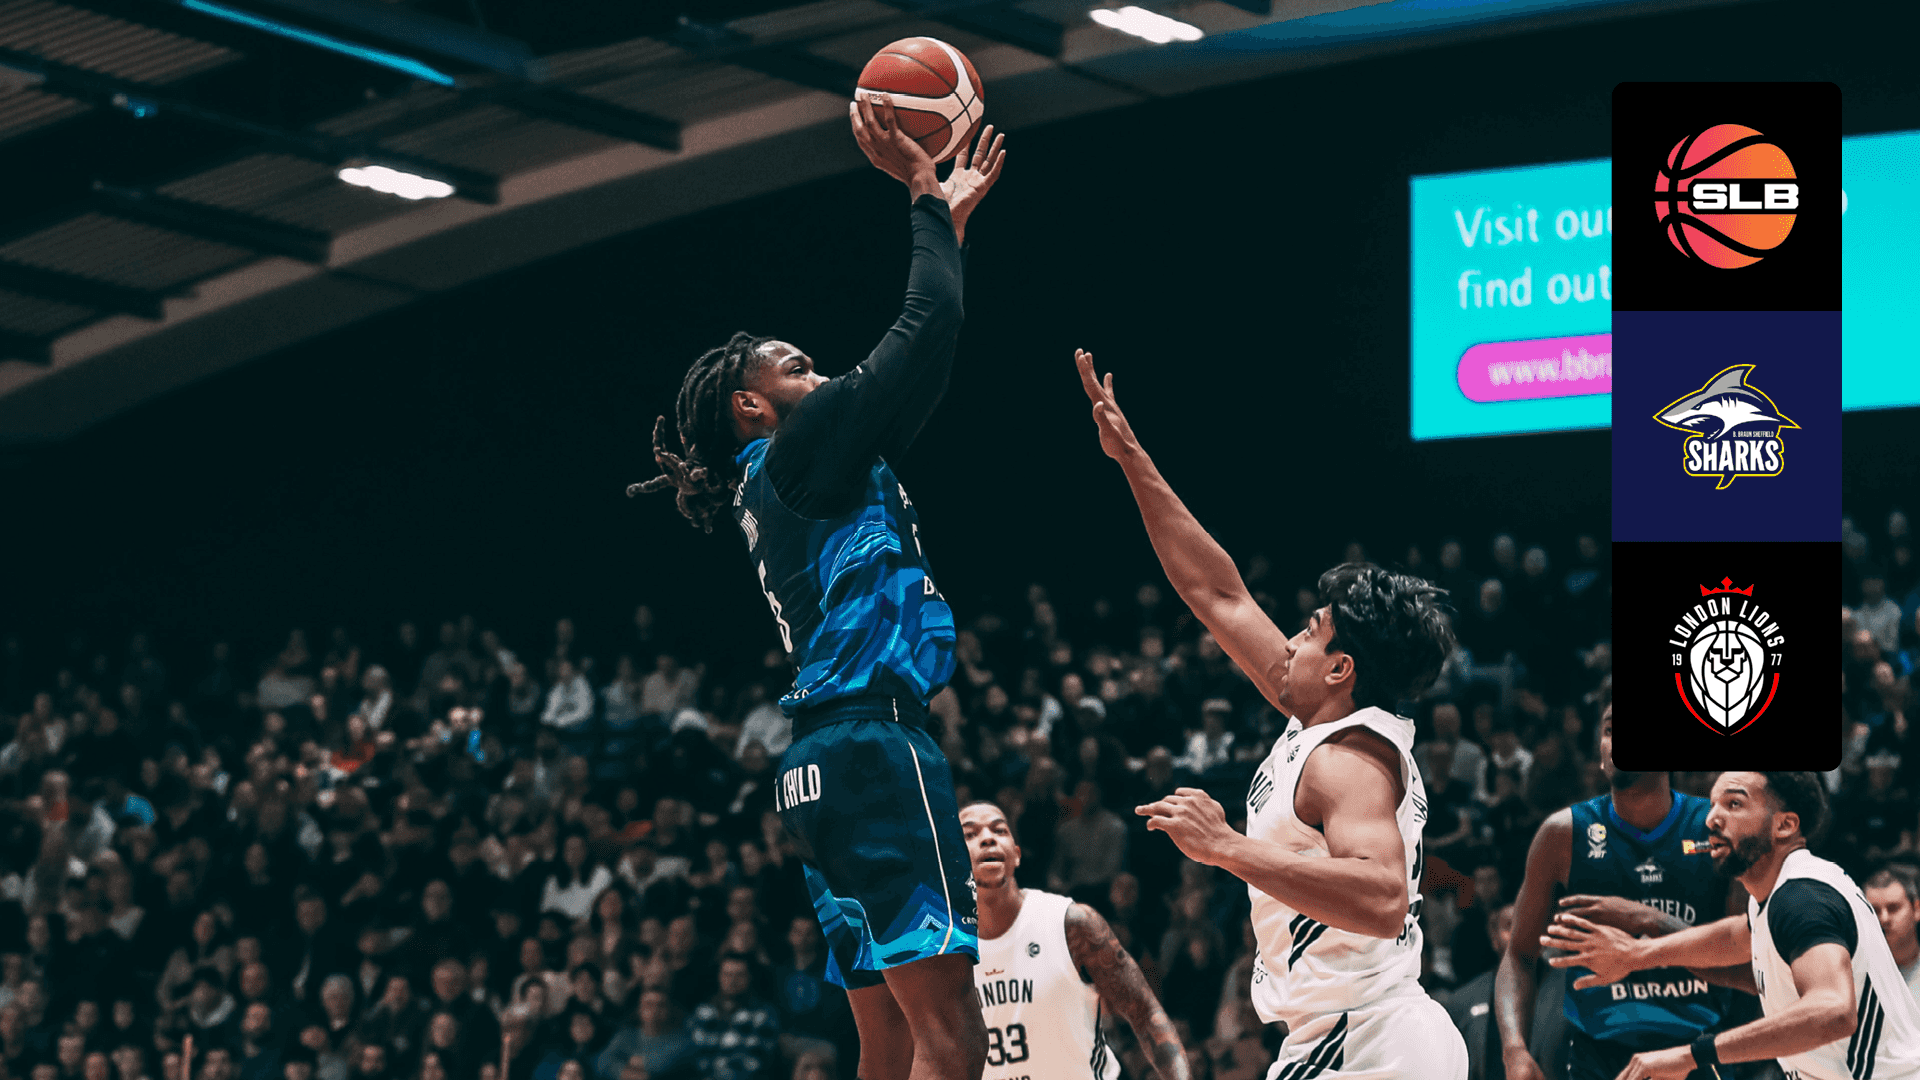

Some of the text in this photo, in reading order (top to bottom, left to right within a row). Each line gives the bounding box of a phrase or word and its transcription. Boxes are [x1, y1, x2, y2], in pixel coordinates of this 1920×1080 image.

[1454, 203, 1539, 247] Visit
[1458, 265, 1612, 309] find out
[987, 1023, 1030, 1067] 33
